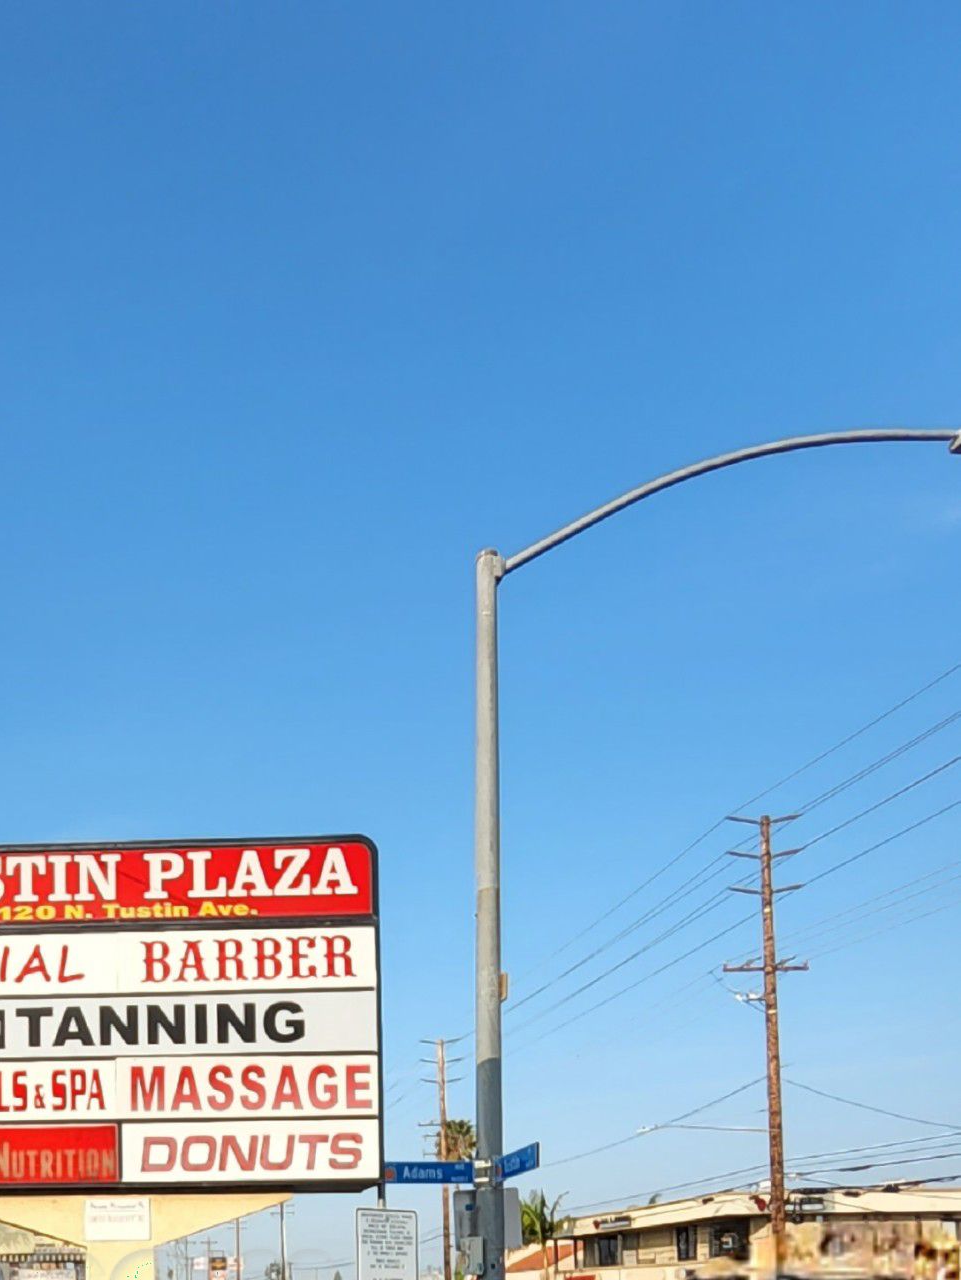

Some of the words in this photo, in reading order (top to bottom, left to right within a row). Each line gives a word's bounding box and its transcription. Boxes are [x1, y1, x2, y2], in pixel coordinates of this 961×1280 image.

[143, 847, 358, 899] PLAZA
[64, 904, 93, 919] N.
[101, 901, 189, 918] Tustin
[197, 901, 259, 916] Ave.
[140, 934, 357, 983] BARBER
[15, 1001, 306, 1048] TANNING
[34, 1084, 45, 1109] &
[51, 1068, 106, 1111] SPA
[129, 1063, 373, 1112] MASSAGE
[140, 1132, 364, 1173] DONUTS
[402, 1165, 443, 1180] Adams
